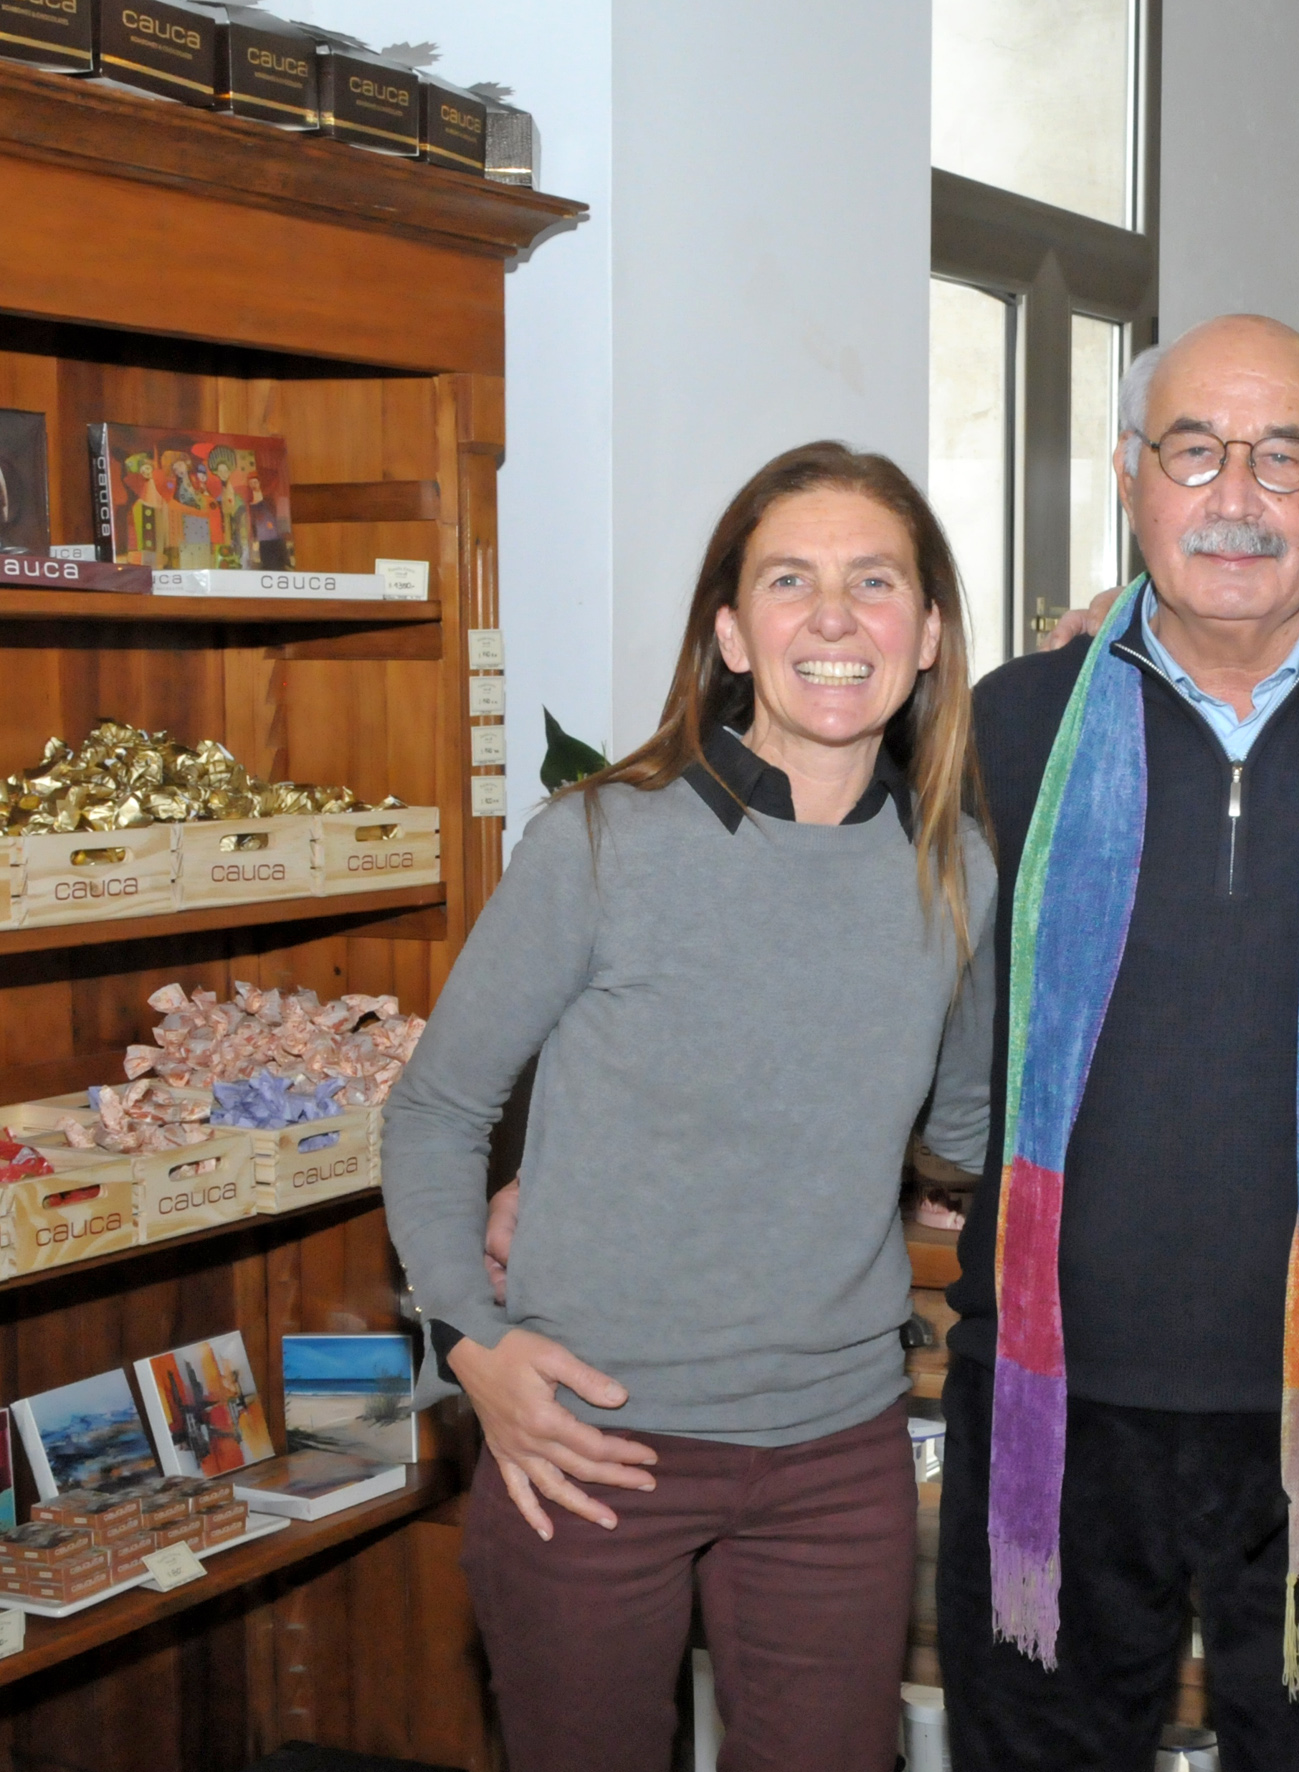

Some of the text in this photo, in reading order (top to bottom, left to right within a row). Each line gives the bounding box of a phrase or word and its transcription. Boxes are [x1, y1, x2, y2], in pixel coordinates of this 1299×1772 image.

[122, 10, 200, 49] cauca
[247, 47, 308, 77] cauca
[350, 76, 409, 106] cauca
[441, 105, 482, 134] cauca
[97, 456, 111, 536] cauca
[3, 558, 79, 580] auca
[261, 574, 336, 591] cauca
[211, 863, 286, 883] cauca
[346, 852, 414, 872] cauca
[54, 876, 139, 901] cauca
[293, 1156, 358, 1189] cauca
[158, 1182, 237, 1215] cauca
[35, 1212, 122, 1247] cauca
